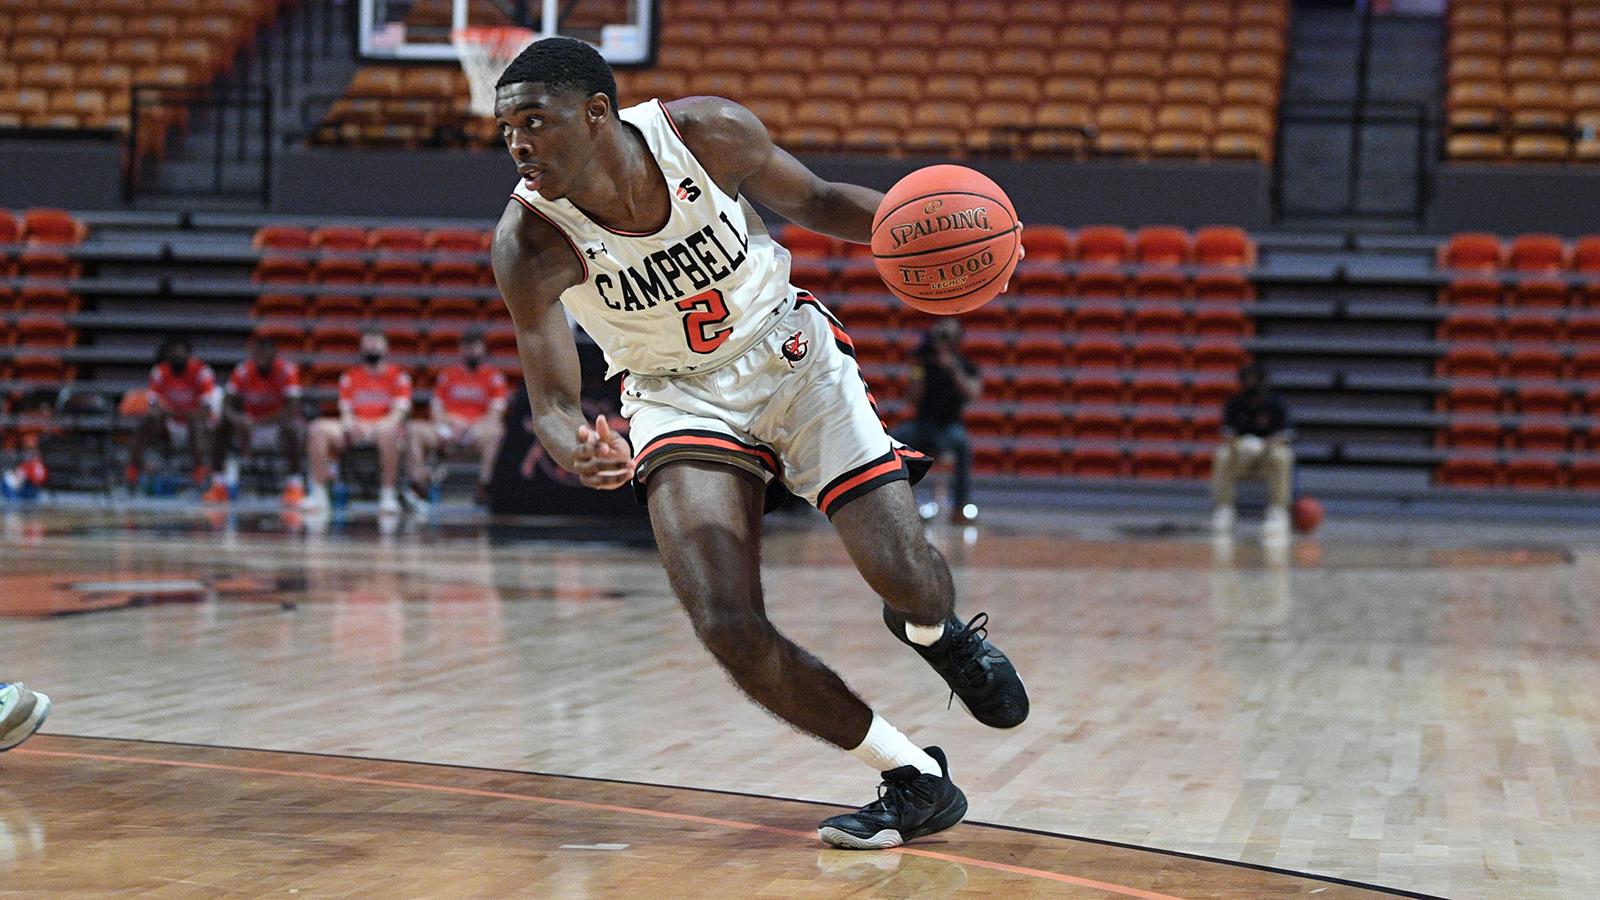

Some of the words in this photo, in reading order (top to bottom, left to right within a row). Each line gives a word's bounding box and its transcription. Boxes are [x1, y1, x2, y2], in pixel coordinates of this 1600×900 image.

[890, 208, 990, 249] SPALDING
[595, 211, 748, 312] CAMPBELL
[900, 251, 993, 283] TF-1000
[931, 276, 968, 289] LEGACY
[674, 287, 734, 355] 2
